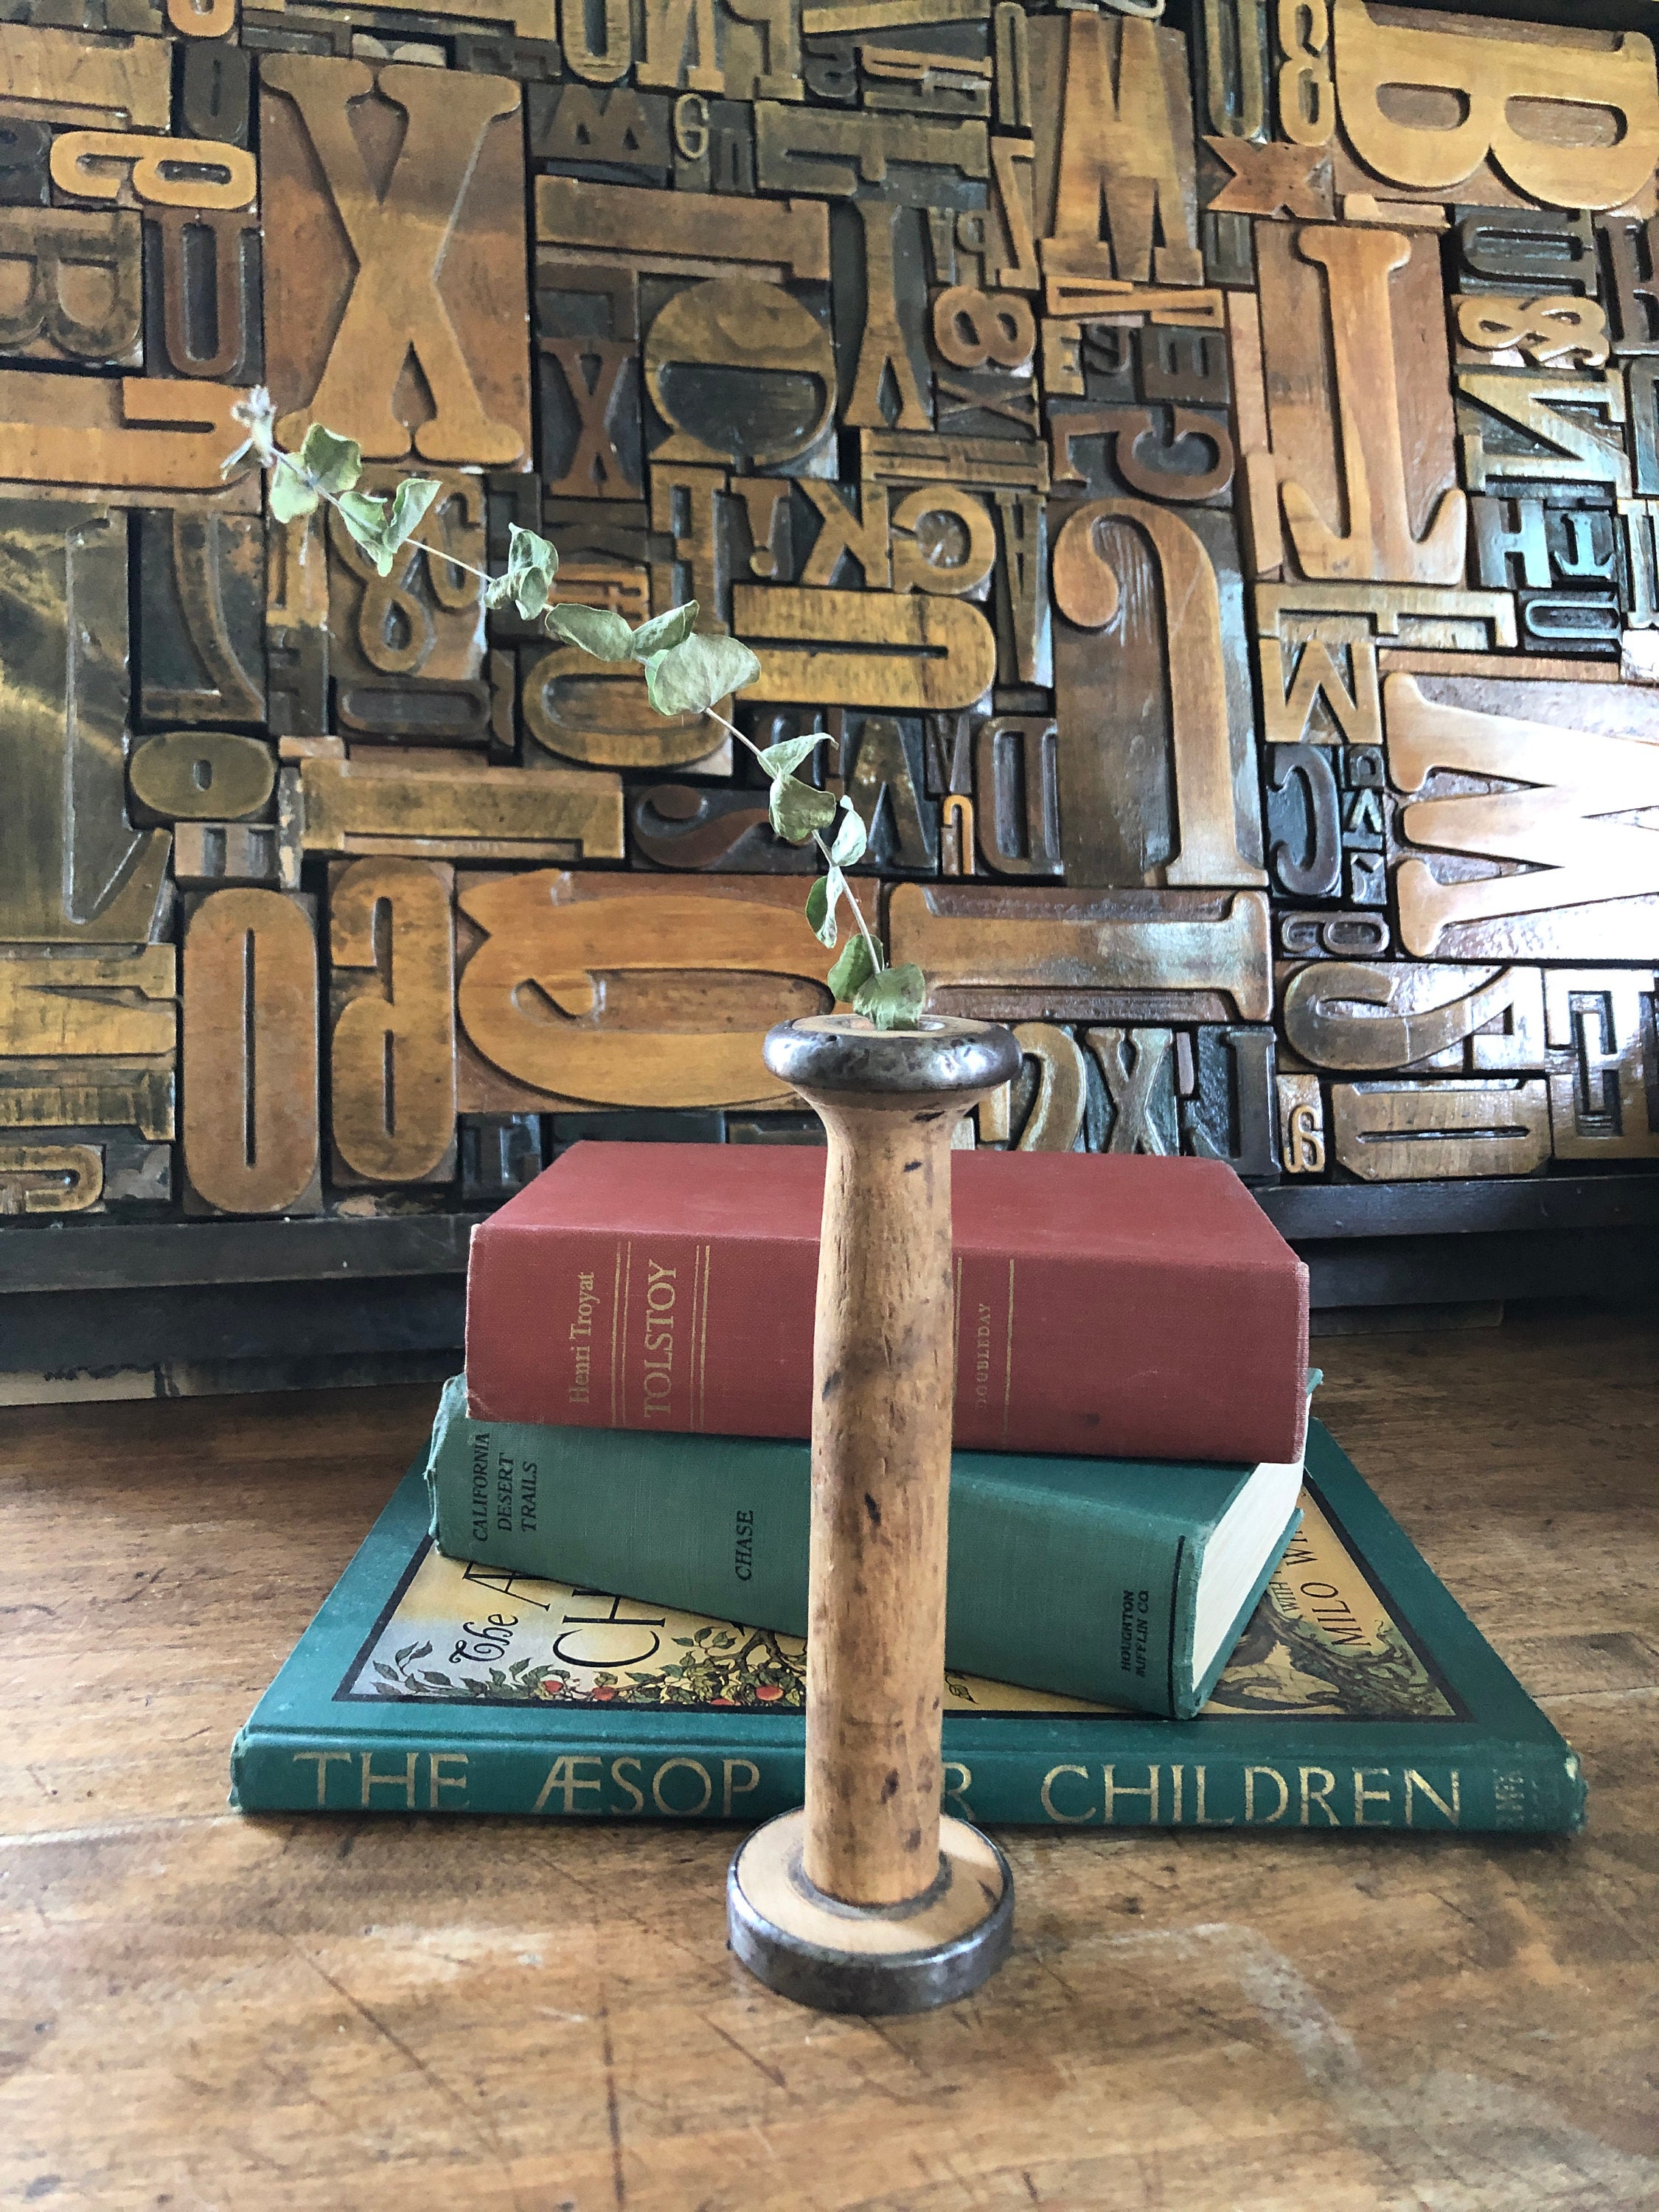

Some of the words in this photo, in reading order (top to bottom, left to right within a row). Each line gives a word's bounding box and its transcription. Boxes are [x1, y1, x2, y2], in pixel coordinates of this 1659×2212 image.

[568, 1271, 601, 1340] Troyat
[643, 1258, 677, 1418] TOLSTOY
[569, 1346, 591, 1404] Henri
[472, 1433, 490, 1542] CALIFORNIA
[497, 1452, 515, 1532] DESERT
[521, 1461, 538, 1532] TRAILS
[734, 1509, 754, 1582] CHASE
[448, 1613, 519, 1663] The
[1121, 1590, 1135, 1672] HOUGHTON
[1135, 1618, 1149, 1678] MIFFLIN
[1300, 1582, 1372, 1646] MILO
[293, 1751, 470, 1809] THE
[1040, 1764, 1460, 1828] CHILDREN
